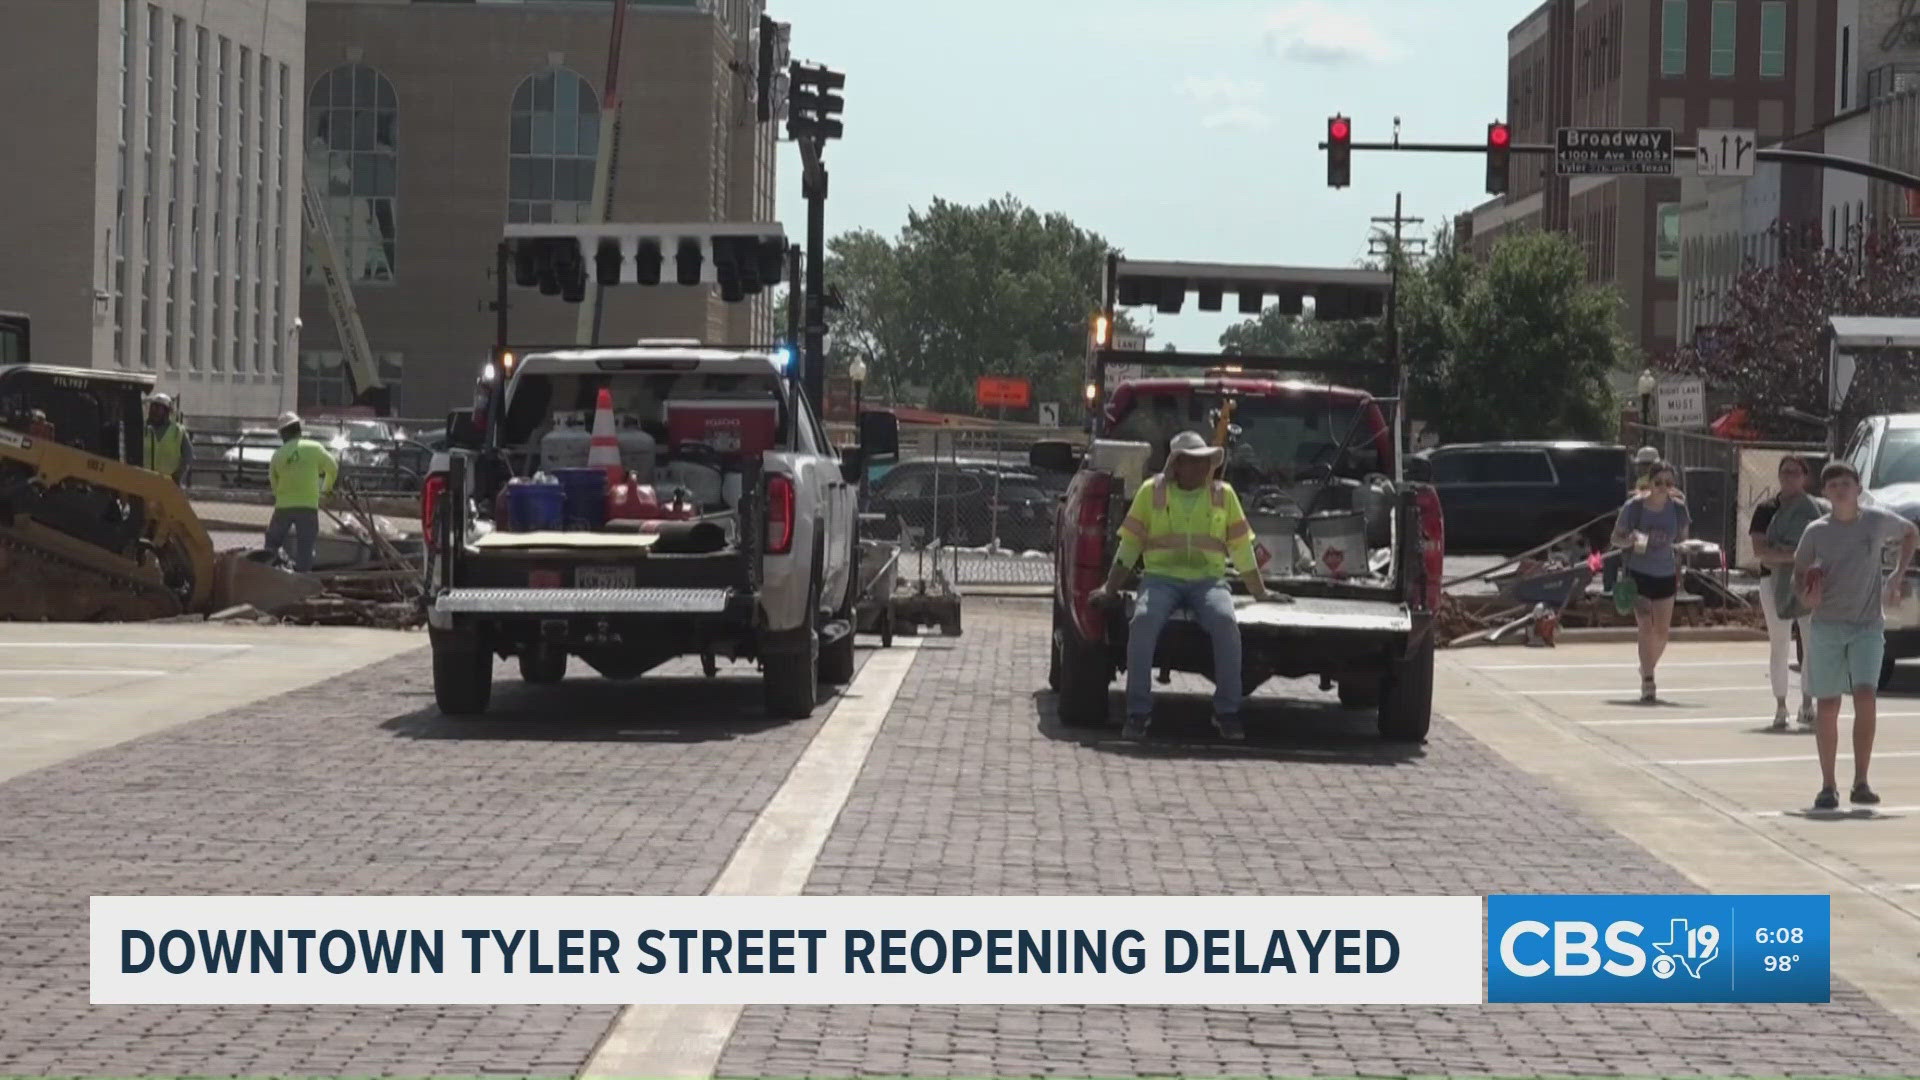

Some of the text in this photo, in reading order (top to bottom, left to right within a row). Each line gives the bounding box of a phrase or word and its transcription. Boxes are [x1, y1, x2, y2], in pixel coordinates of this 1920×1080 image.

[1567, 130, 1661, 149] Broadway
[1604, 151, 1624, 160] Ave
[1561, 163, 1585, 173] Tyler
[1641, 163, 1669, 172] Texas
[1667, 398, 1693, 409] MUST
